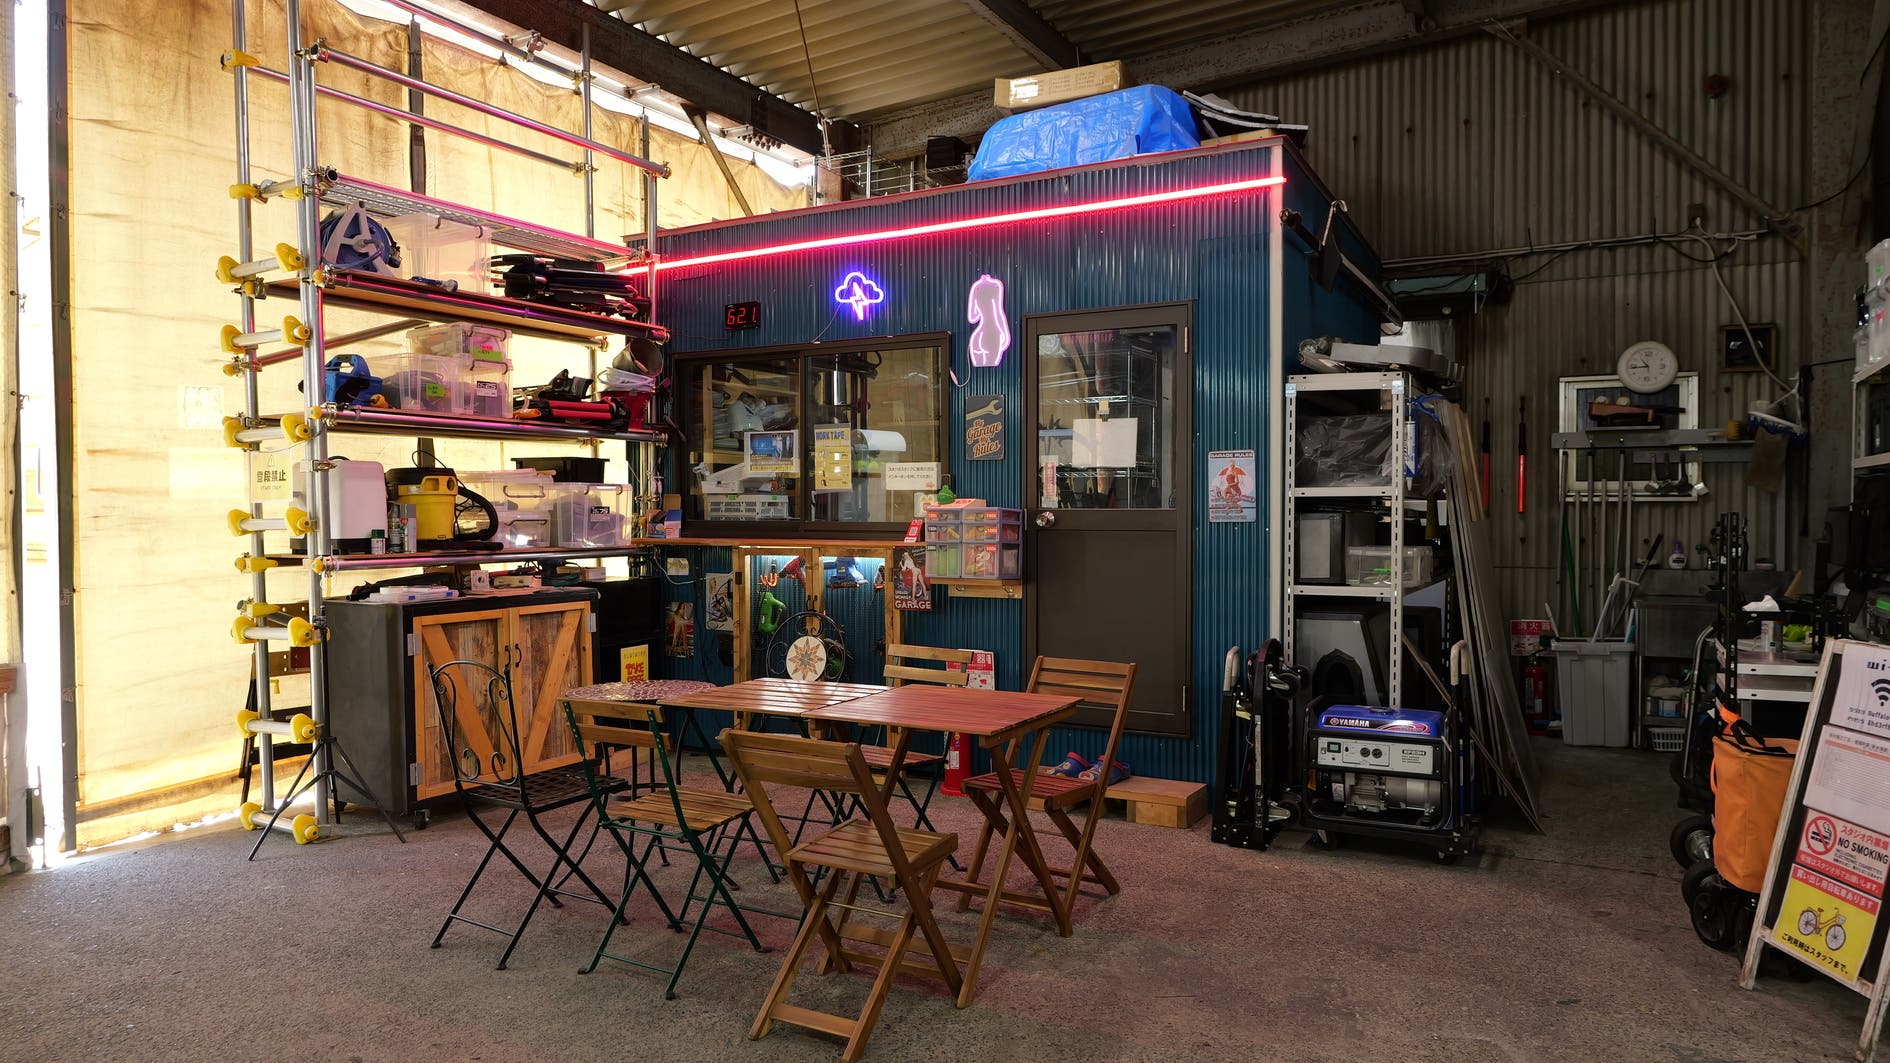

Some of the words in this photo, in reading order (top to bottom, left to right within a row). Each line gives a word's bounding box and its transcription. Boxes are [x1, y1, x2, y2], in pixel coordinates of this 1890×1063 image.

[816, 431, 830, 441] WORK
[830, 430, 845, 441] TAPE
[967, 421, 1002, 444] Garage
[973, 440, 1000, 458] Rules
[895, 601, 932, 609] GARAGE
[625, 661, 645, 675] TAKE
[1340, 719, 1370, 728] YAMAHA
[1838, 837, 1850, 849] NO
[1851, 842, 1889, 865] SMOKING
